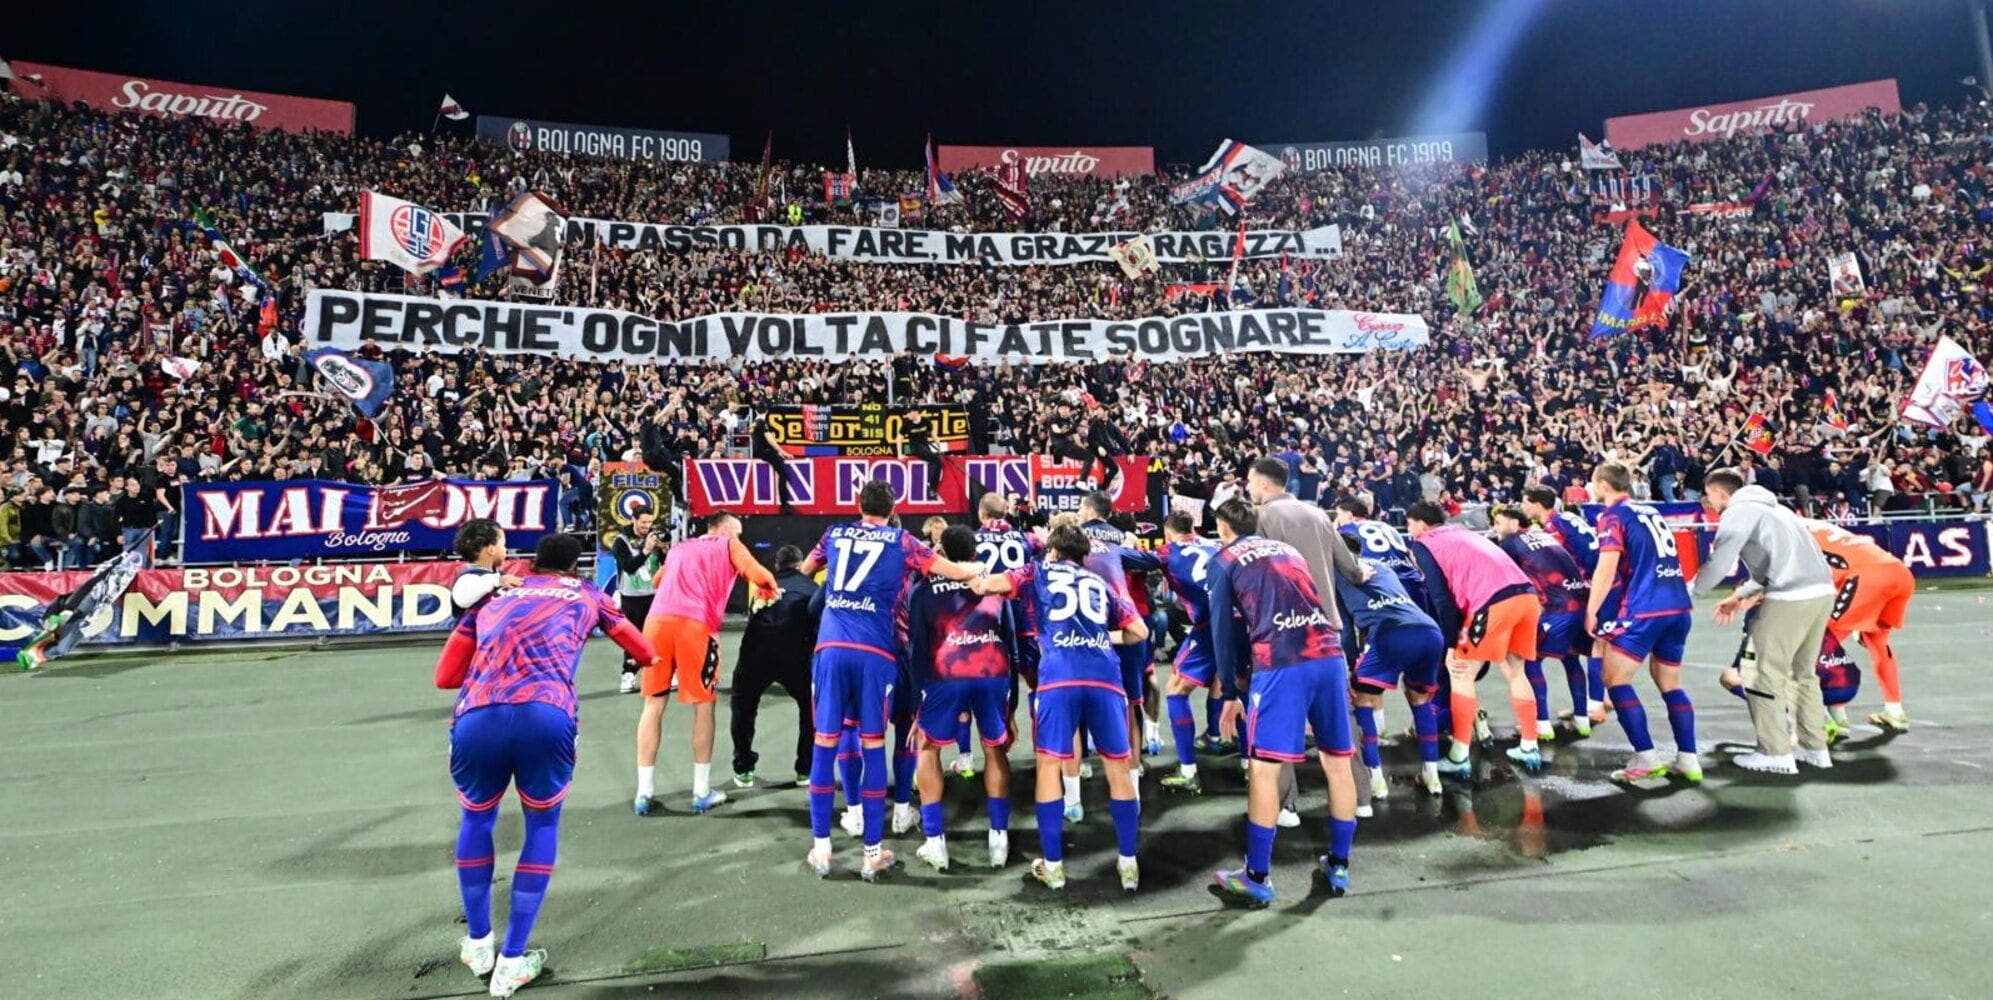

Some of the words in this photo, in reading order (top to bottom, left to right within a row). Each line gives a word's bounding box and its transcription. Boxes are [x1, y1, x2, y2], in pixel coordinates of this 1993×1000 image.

[111, 80, 268, 121] Saputo
[1684, 99, 1815, 138] Saputo
[537, 127, 625, 158] BOLOGNA
[632, 134, 654, 161] FC
[658, 137, 702, 162] 1909
[1305, 145, 1381, 171] BOLOGNA
[1387, 142, 1408, 168] FC
[1411, 140, 1453, 164] 1909
[608, 224, 746, 257] PASSO
[757, 226, 812, 257] DA
[827, 228, 939, 260] FARE,
[945, 235, 1003, 262] MA
[1153, 233, 1306, 258] RAGAZZI
[317, 295, 575, 351] PERCHE'
[581, 312, 708, 357] OGNI
[719, 314, 895, 356] VOLTA
[905, 315, 951, 356] CI
[964, 321, 1094, 358] FATE
[1105, 311, 1331, 356] SOGNARE
[864, 414, 881, 424] 41
[846, 446, 893, 456] BOLOGNA
[612, 473, 660, 490] FILA
[694, 459, 814, 506] WIN
[197, 486, 349, 540] MAI
[324, 530, 410, 551] Bologna
[1358, 521, 1407, 553] 80
[1637, 514, 1678, 558] 18
[183, 564, 393, 588] BOLOGNA
[833, 537, 885, 592] 17
[826, 594, 876, 614] Selenella
[1047, 570, 1108, 624] 30
[945, 629, 1003, 647] Selenella
[1052, 630, 1111, 650] Selenella
